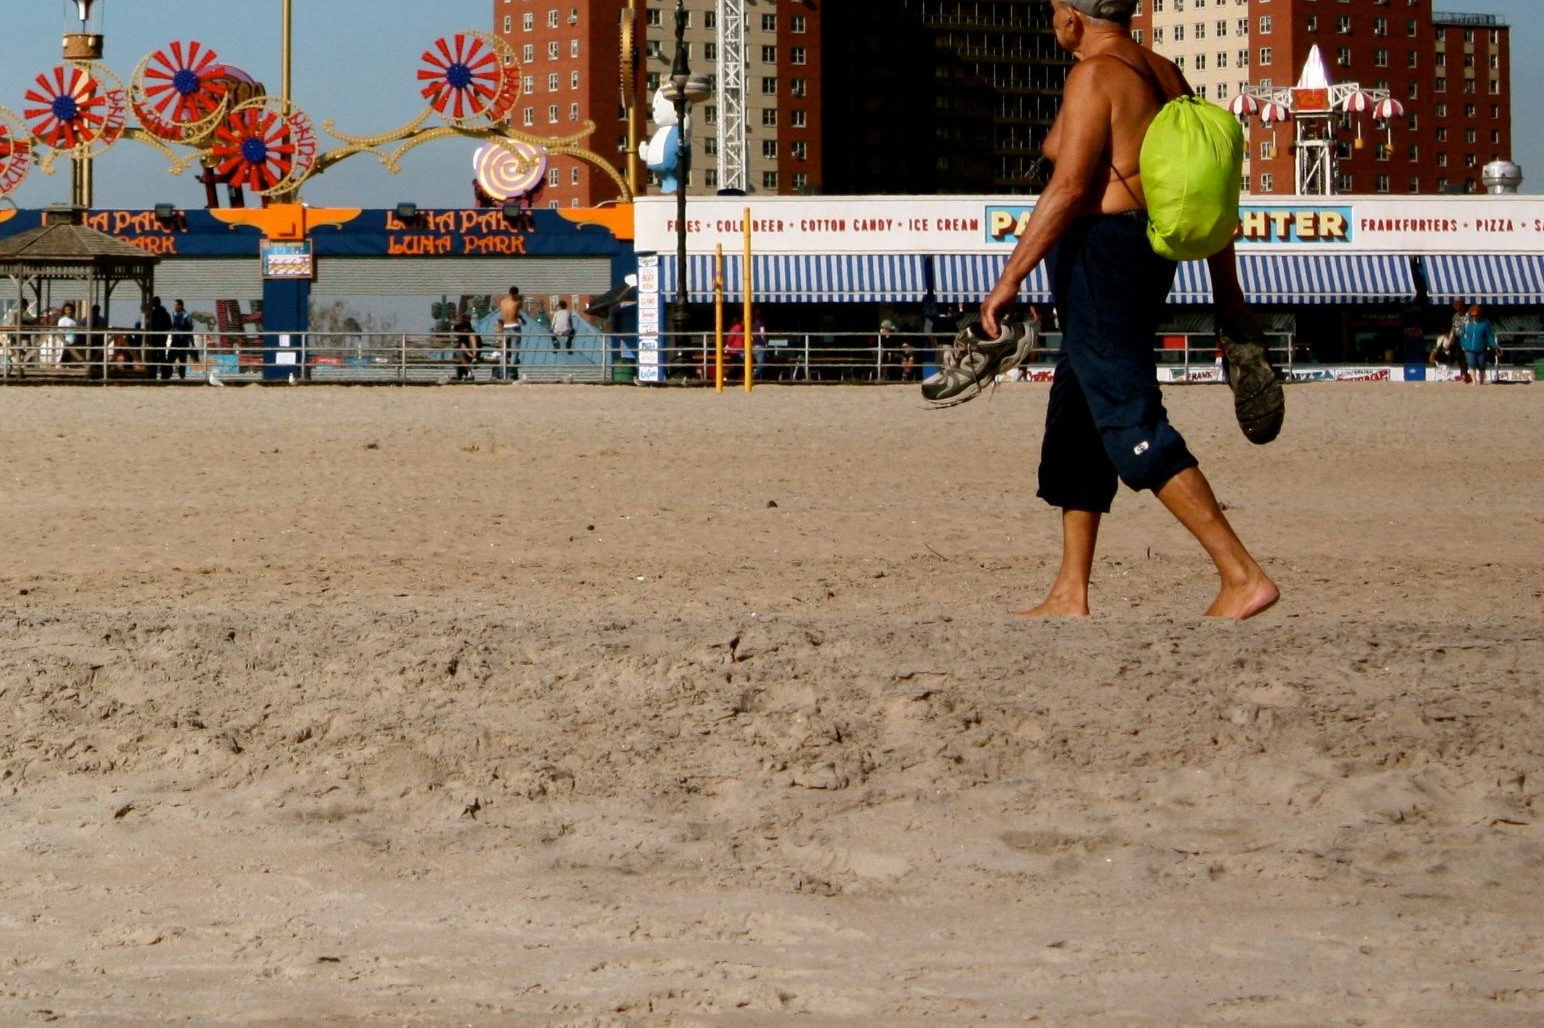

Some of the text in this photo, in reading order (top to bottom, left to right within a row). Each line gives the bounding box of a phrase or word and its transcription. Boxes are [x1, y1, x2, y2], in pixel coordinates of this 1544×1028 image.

[667, 220, 701, 232] FES
[752, 220, 784, 232] BEER
[801, 219, 893, 232] COTTON CANDY
[909, 219, 978, 231] ICE CREAM
[991, 210, 1033, 239] PA
[1361, 219, 1458, 232] FRANKFURTERS
[1476, 219, 1514, 232] PIZZA
[387, 235, 526, 254] LUNA PARK
